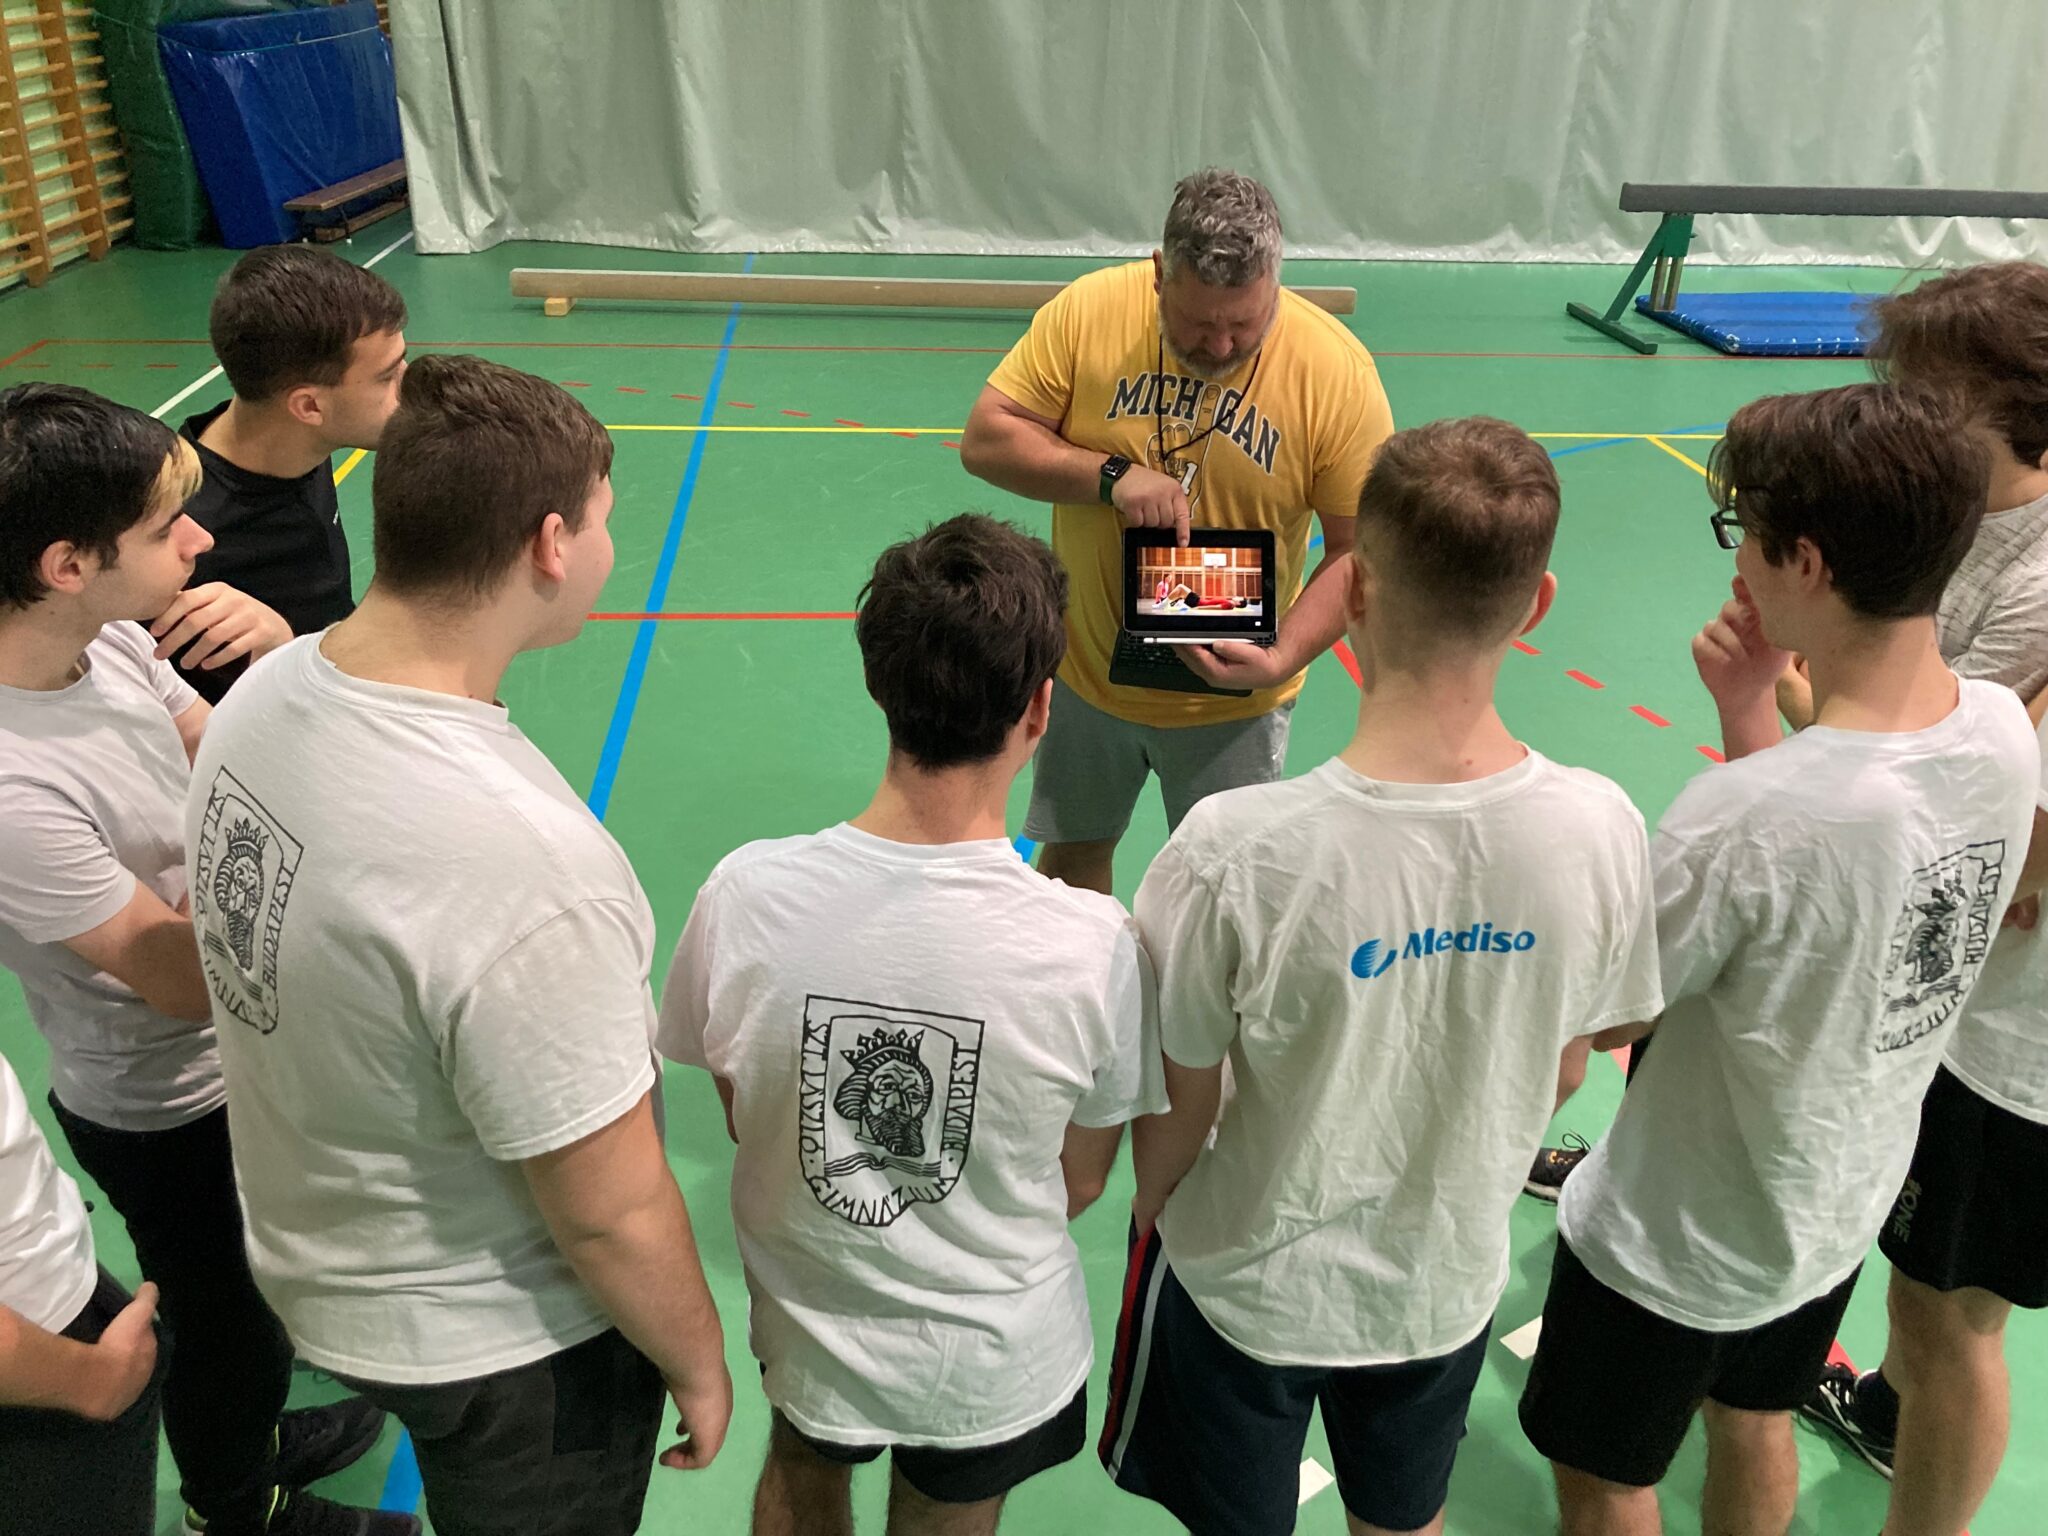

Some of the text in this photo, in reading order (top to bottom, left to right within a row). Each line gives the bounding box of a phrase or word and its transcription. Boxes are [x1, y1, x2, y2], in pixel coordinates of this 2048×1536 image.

[262, 857, 294, 991] BUDAPEST
[1402, 922, 1536, 959] Mediso
[942, 1041, 981, 1152] BUDAPEST
